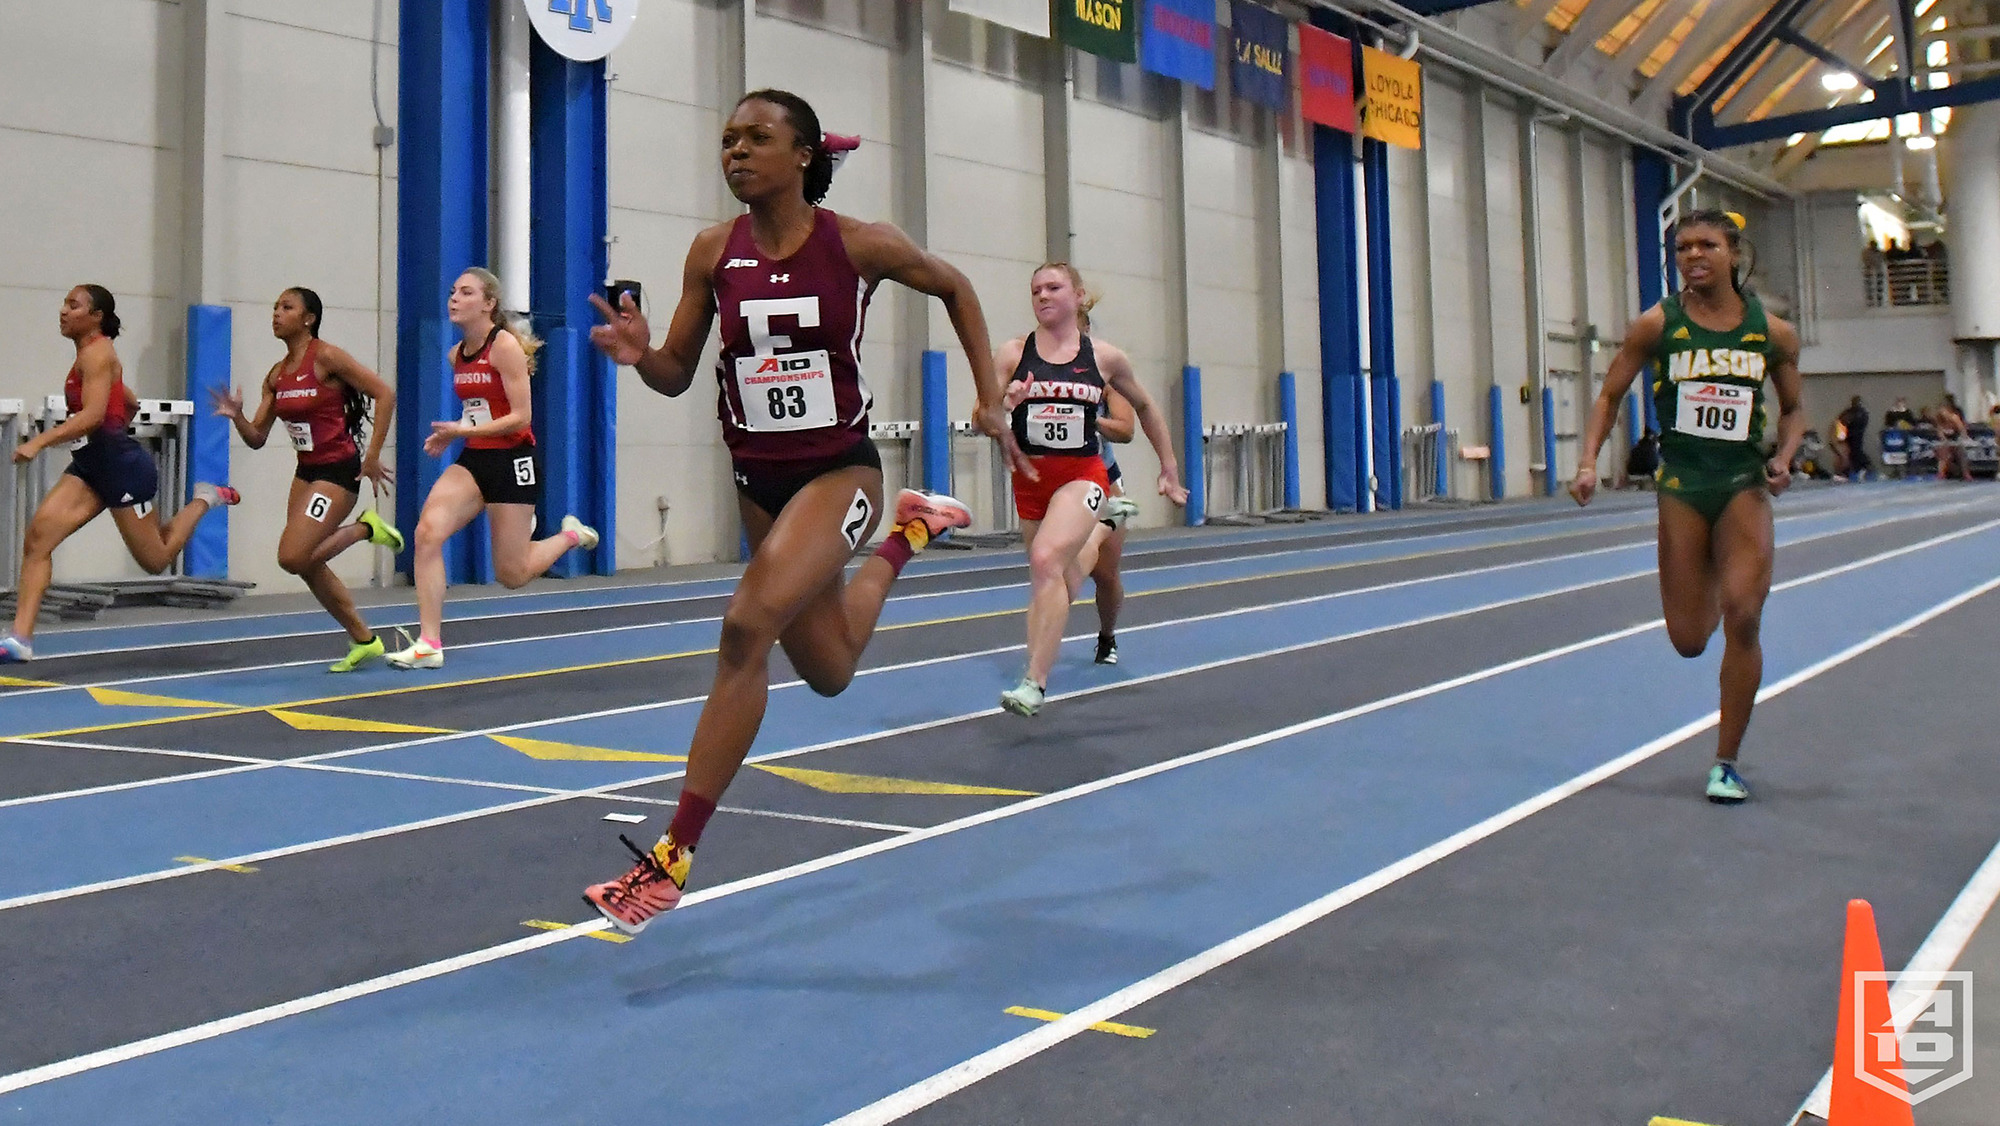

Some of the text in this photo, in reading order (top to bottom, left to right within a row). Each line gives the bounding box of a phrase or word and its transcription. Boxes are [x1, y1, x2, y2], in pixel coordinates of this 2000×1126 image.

[1076, 0, 1122, 31] MASON
[1370, 74, 1414, 99] LOYOLA
[756, 358, 811, 374] A10
[1669, 348, 1766, 382] MASON
[744, 370, 825, 385] CHAMPIONSHIPS
[767, 386, 807, 420] 83
[1028, 381, 1102, 404] AYTON
[1697, 385, 1740, 398] A10
[1695, 405, 1737, 431] 109
[1044, 422, 1068, 441] 35
[518, 460, 531, 483] 5
[311, 497, 327, 518] 6
[1087, 487, 1102, 512] 3
[845, 498, 868, 546] 2
